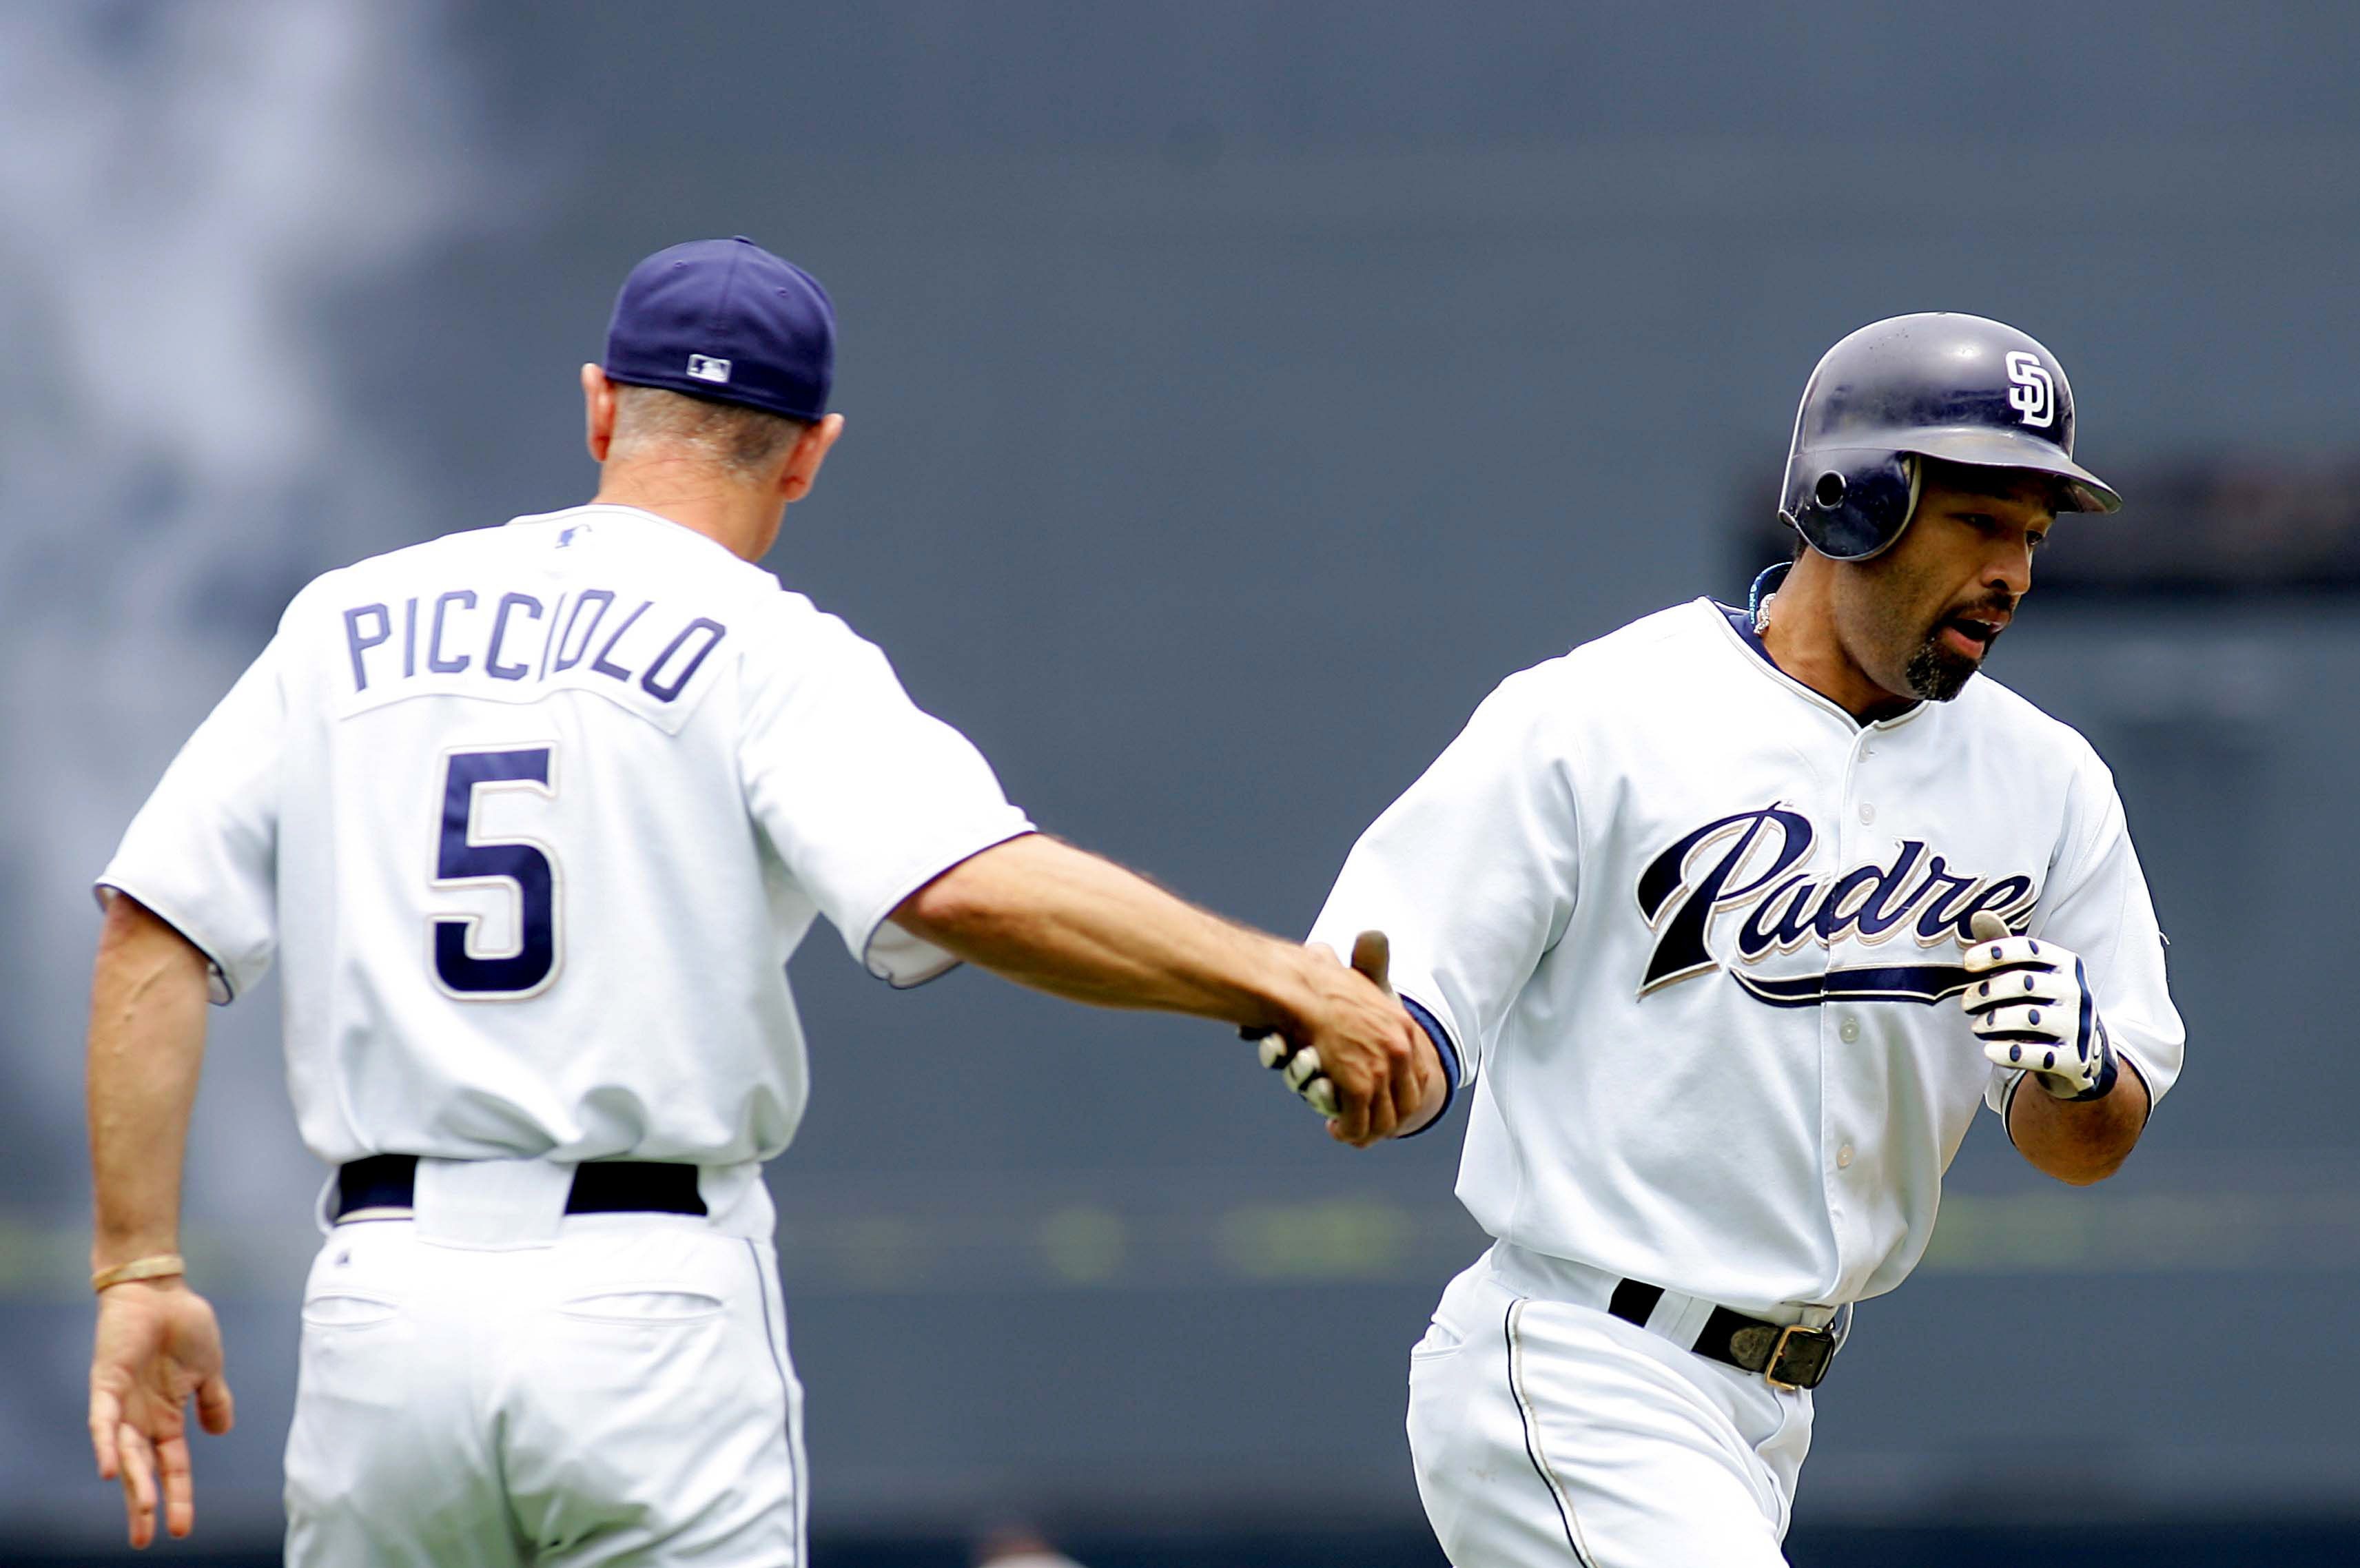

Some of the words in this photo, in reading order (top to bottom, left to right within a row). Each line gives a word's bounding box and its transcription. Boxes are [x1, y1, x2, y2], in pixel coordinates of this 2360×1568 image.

[2005, 350, 2054, 428] SD
[343, 589, 726, 703] PICCIOLO
[427, 741, 564, 1000] 5
[1635, 800, 2038, 1004] Padre
